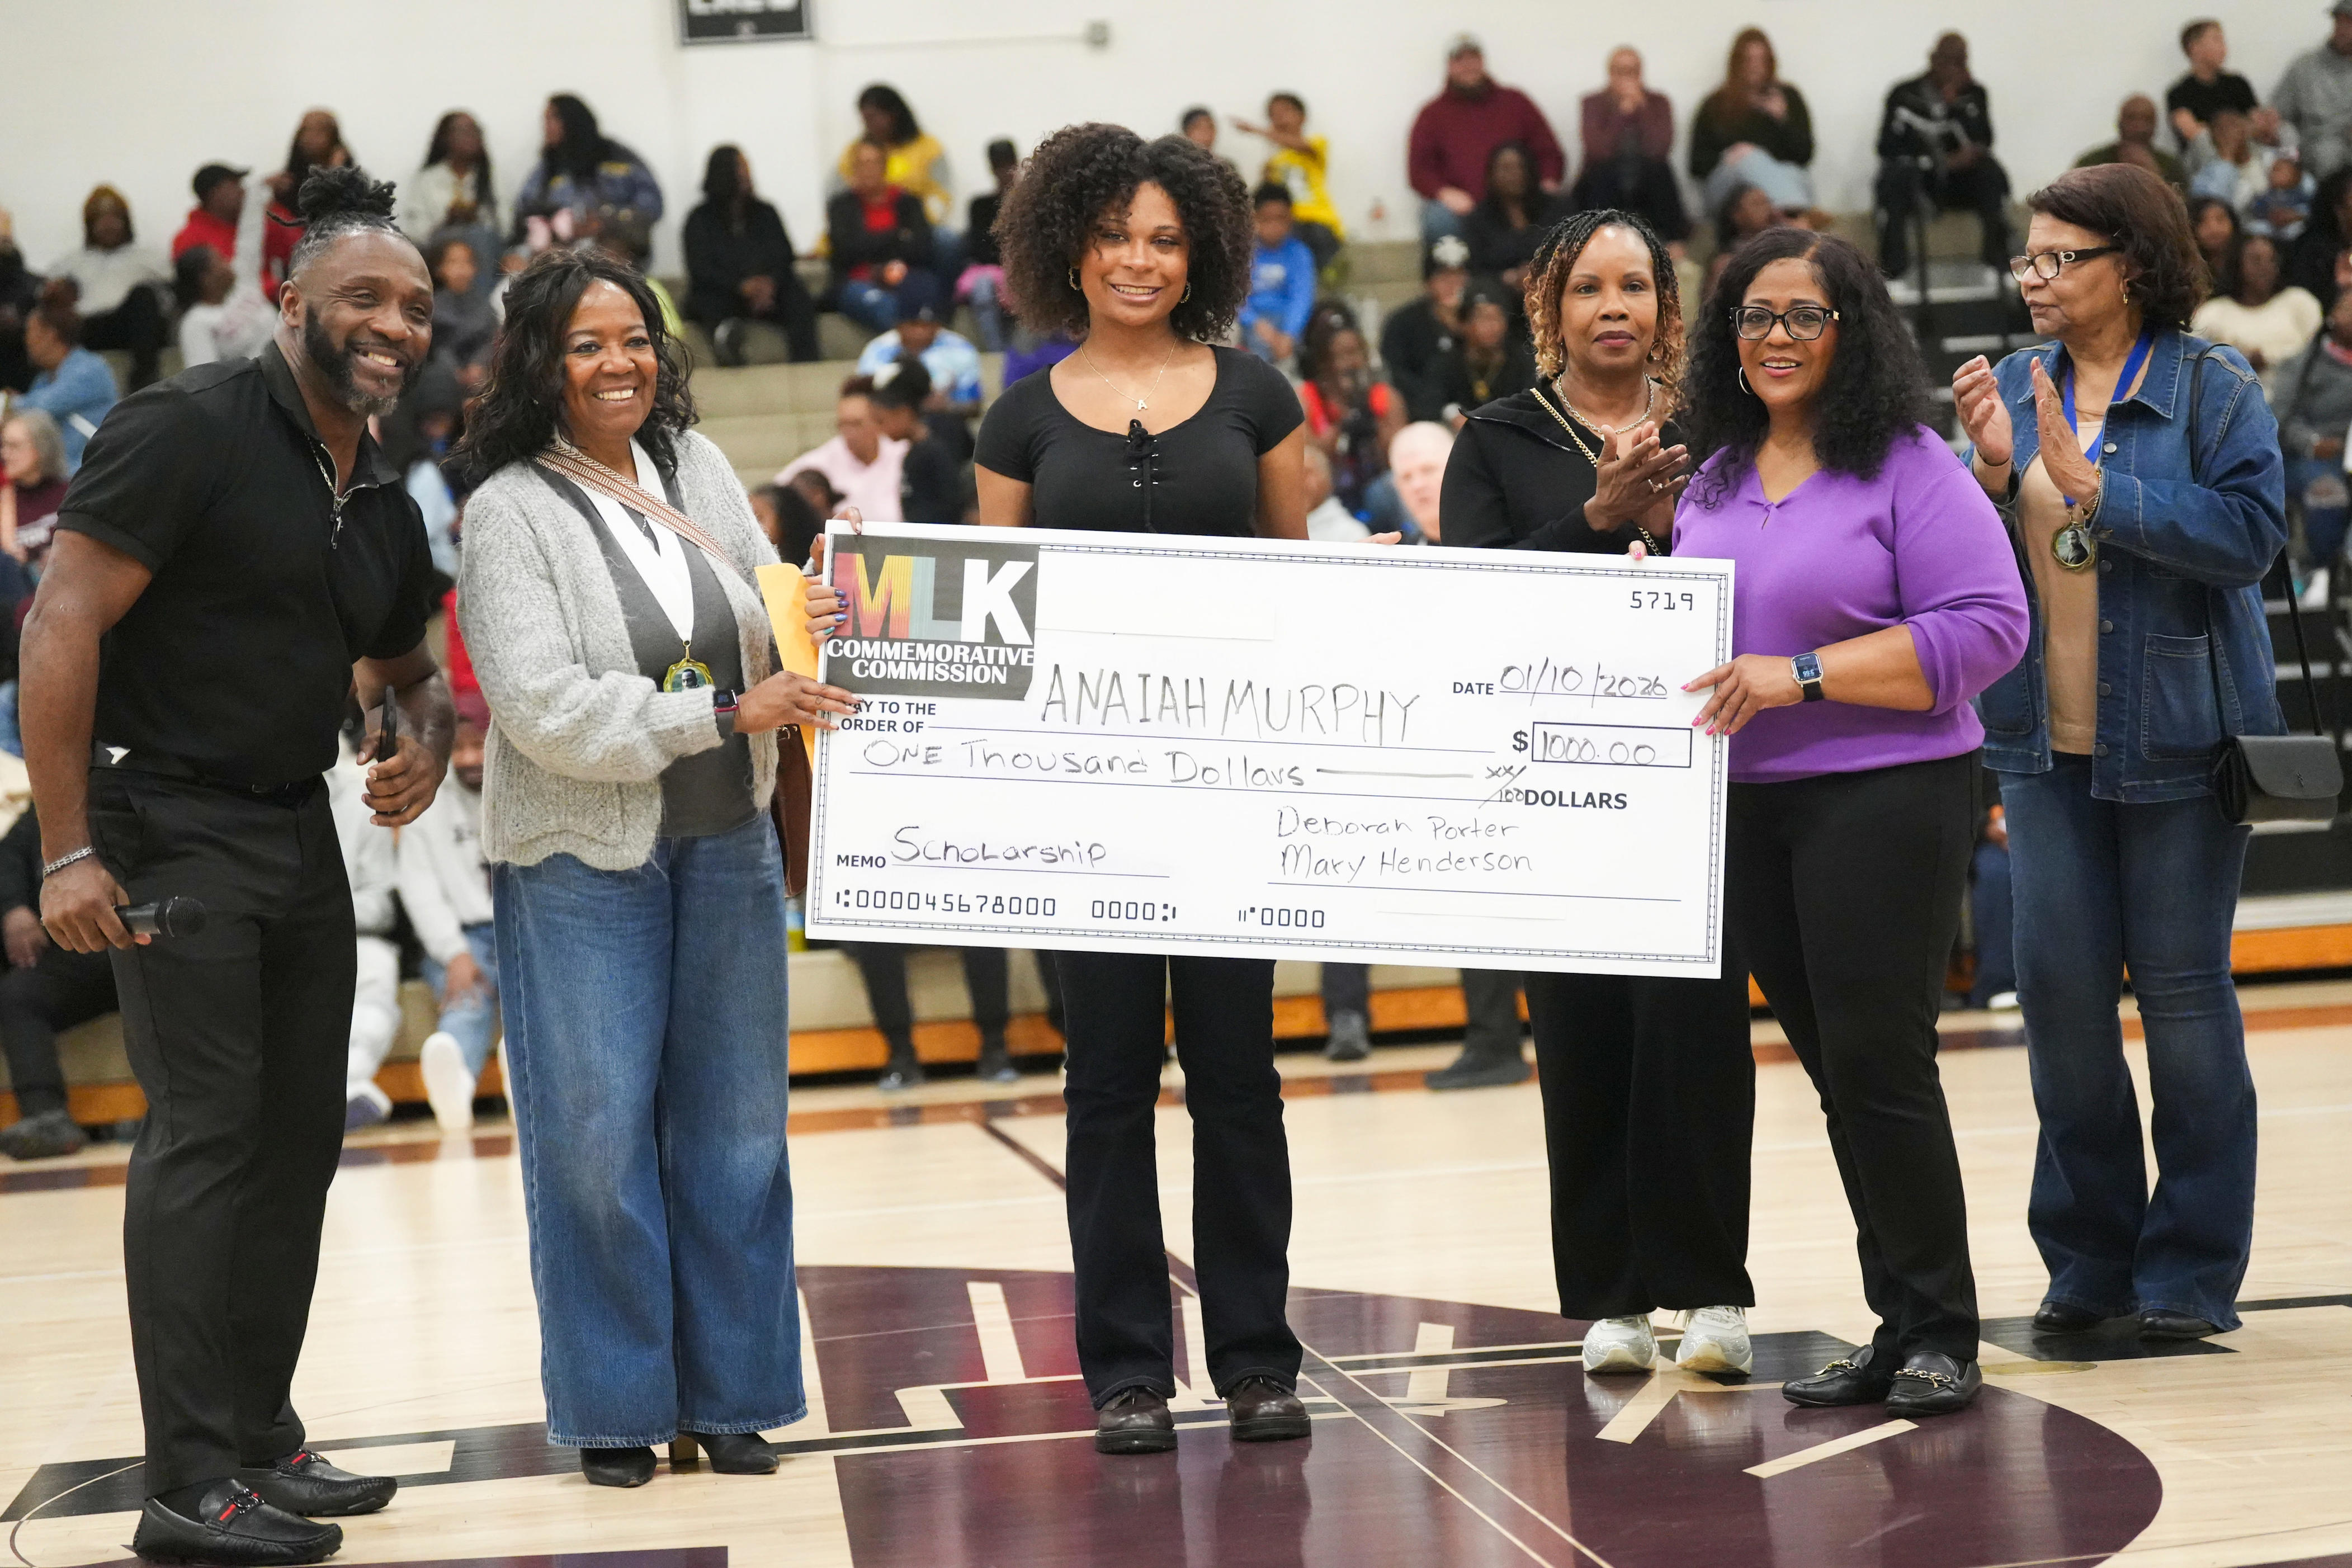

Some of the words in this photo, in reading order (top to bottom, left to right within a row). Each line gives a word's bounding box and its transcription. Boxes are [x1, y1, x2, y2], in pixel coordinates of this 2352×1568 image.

[834, 552, 1034, 645] MLK
[1630, 591, 1693, 611] 5719
[826, 639, 1034, 667] COMMEMORATIVE
[852, 660, 1007, 684] COMMISSION
[1500, 656, 1667, 708] 01/10/2026
[1453, 682, 1494, 695] DATE
[879, 702, 899, 714] TO
[905, 703, 936, 715] THE
[1041, 664, 1205, 727] ANAIAH
[1221, 679, 1420, 745] MURPHY
[841, 718, 898, 732] ORDER
[903, 721, 924, 733] OF
[864, 737, 942, 766] ONE
[1513, 730, 1528, 753] $
[1543, 730, 1655, 764] 1000.00
[1524, 789, 1627, 810] DOLLARS
[1428, 816, 1519, 840] Porter
[836, 854, 886, 868] MEMO
[1282, 844, 1366, 883] Mary
[1381, 847, 1533, 876] Henderson
